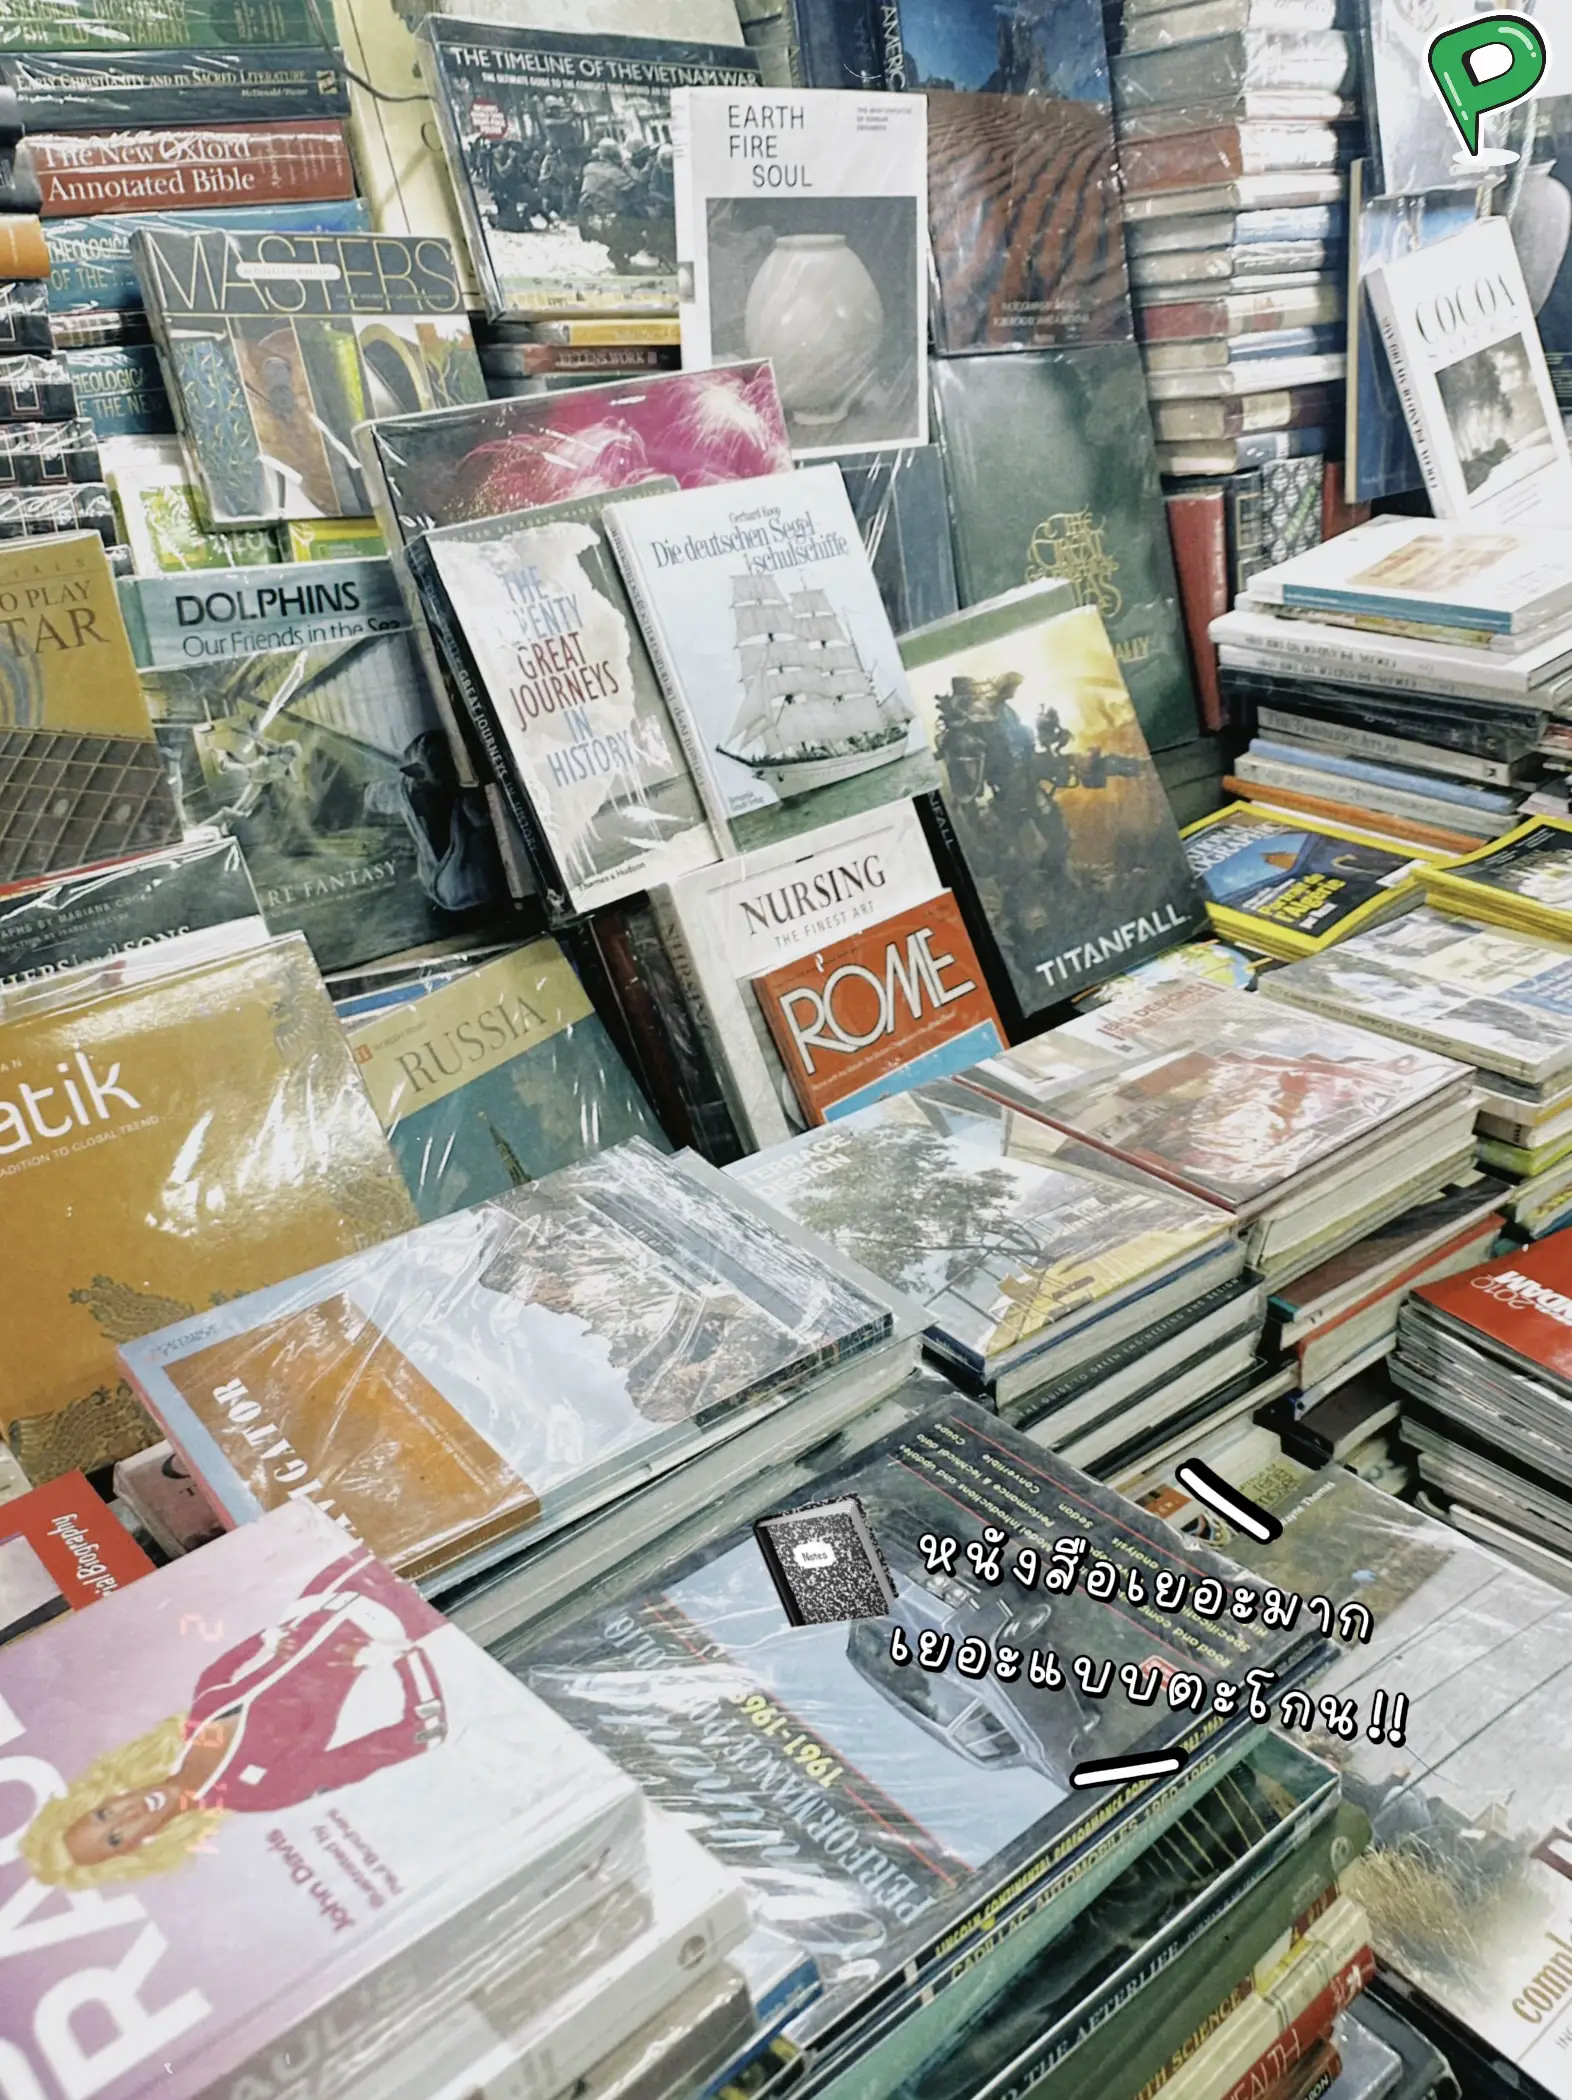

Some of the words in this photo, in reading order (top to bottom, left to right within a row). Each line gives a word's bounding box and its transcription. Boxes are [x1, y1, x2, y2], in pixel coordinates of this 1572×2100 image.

[61, 71, 146, 91] CHRISTIANITY
[150, 74, 173, 86] AND
[174, 73, 190, 86] ITS
[192, 69, 238, 86] SACRED
[240, 68, 307, 85] LITERATURE
[449, 47, 491, 68] THE
[494, 51, 575, 75] TIMELINE
[579, 59, 605, 78] OF
[607, 61, 643, 81] THE
[643, 63, 719, 86] VIETNAM
[719, 74, 758, 88] WAR
[728, 105, 805, 130] EARTH
[43, 142, 93, 169] The
[97, 140, 154, 165] New
[158, 135, 252, 163] Oxford
[729, 134, 778, 159] FIRE
[48, 172, 185, 202] Annotated
[193, 167, 256, 193] Bible
[752, 164, 813, 188] SOUL
[52, 268, 71, 290] OF
[75, 266, 110, 288] THE
[144, 230, 461, 315] MASTERS
[1413, 270, 1517, 345] COCOA
[92, 398, 124, 418] THE
[650, 540, 684, 569] Die
[684, 525, 770, 563] deutschen
[768, 510, 817, 545] Segel
[25, 580, 92, 609] PLAY
[175, 580, 361, 628] DOLPHINS
[502, 566, 549, 604] THE
[0, 607, 110, 659] TAR
[182, 633, 228, 659] Our
[230, 625, 305, 655] Friends
[308, 621, 328, 645] in
[330, 618, 364, 642] the
[517, 632, 588, 680] GREAT
[509, 660, 620, 732] JOURNEYS
[454, 669, 484, 713] GREAT
[471, 712, 513, 780] JOURNEYS
[565, 709, 595, 743] IN
[546, 731, 635, 790] HISTORY
[302, 859, 399, 896] FANTASY
[616, 862, 646, 877] Hudson
[37, 917, 54, 929] BY
[58, 901, 111, 924] MARIANA
[738, 853, 889, 938] NURSING
[773, 930, 801, 949] THE
[803, 912, 848, 941] FINEST
[847, 900, 877, 922] ART
[1034, 904, 1188, 988] TITANFALL
[778, 926, 979, 1077] ROME
[394, 995, 549, 1095] RUSSIA
[53, 1145, 70, 1159] TO
[72, 1130, 118, 1152] GLOBAL
[119, 1114, 161, 1133] TREND
[740, 1132, 853, 1187] TERRACE
[756, 1151, 852, 1203] DESIGN
[1470, 1272, 1527, 1311] 2010
[1019, 1403, 1039, 1419] THE
[1040, 1382, 1073, 1406] GUIDE
[1073, 1372, 1089, 1386] TO
[1088, 1350, 1123, 1375] GREEN
[1121, 1312, 1187, 1355] ENGINEERING
[1186, 1298, 1206, 1315] AND
[1206, 1275, 1243, 1302] DESIGN
[897, 1440, 938, 1472] updates
[914, 1431, 938, 1451] data
[931, 1419, 969, 1449] Coupe
[208, 1372, 357, 1549] VIGATOR
[934, 1443, 985, 1481] technical
[936, 1467, 959, 1487] and
[979, 1450, 1044, 1497] Convertible
[953, 1479, 1024, 1530] Introductions
[989, 1480, 1058, 1531] Performance
[1055, 1500, 1095, 1532] Sedan
[1302, 1480, 1337, 1506] Thomas
[41, 1505, 111, 1587] Biography
[1015, 1523, 1056, 1556] Model
[1109, 1534, 1162, 1573] analysis
[597, 1606, 735, 1744] POOLIO
[724, 1722, 936, 1935] PERFORMANCE
[260, 1824, 316, 1889] Davis
[932, 1912, 987, 1958] LINCOLN
[982, 1854, 1056, 1916] CONTINENTAL
[1048, 1793, 1131, 1861] PERFORMANCE
[305, 1877, 357, 1937] John
[945, 1907, 1035, 1982] CADILLAC
[1029, 1817, 1144, 1912] AUTOMOBILES
[1018, 2038, 1076, 2089] THE
[1065, 1940, 1190, 2044] AFTERLIFE
[1158, 1988, 1255, 2073] SCIENCE
[1215, 2026, 1317, 2100] EALTH
